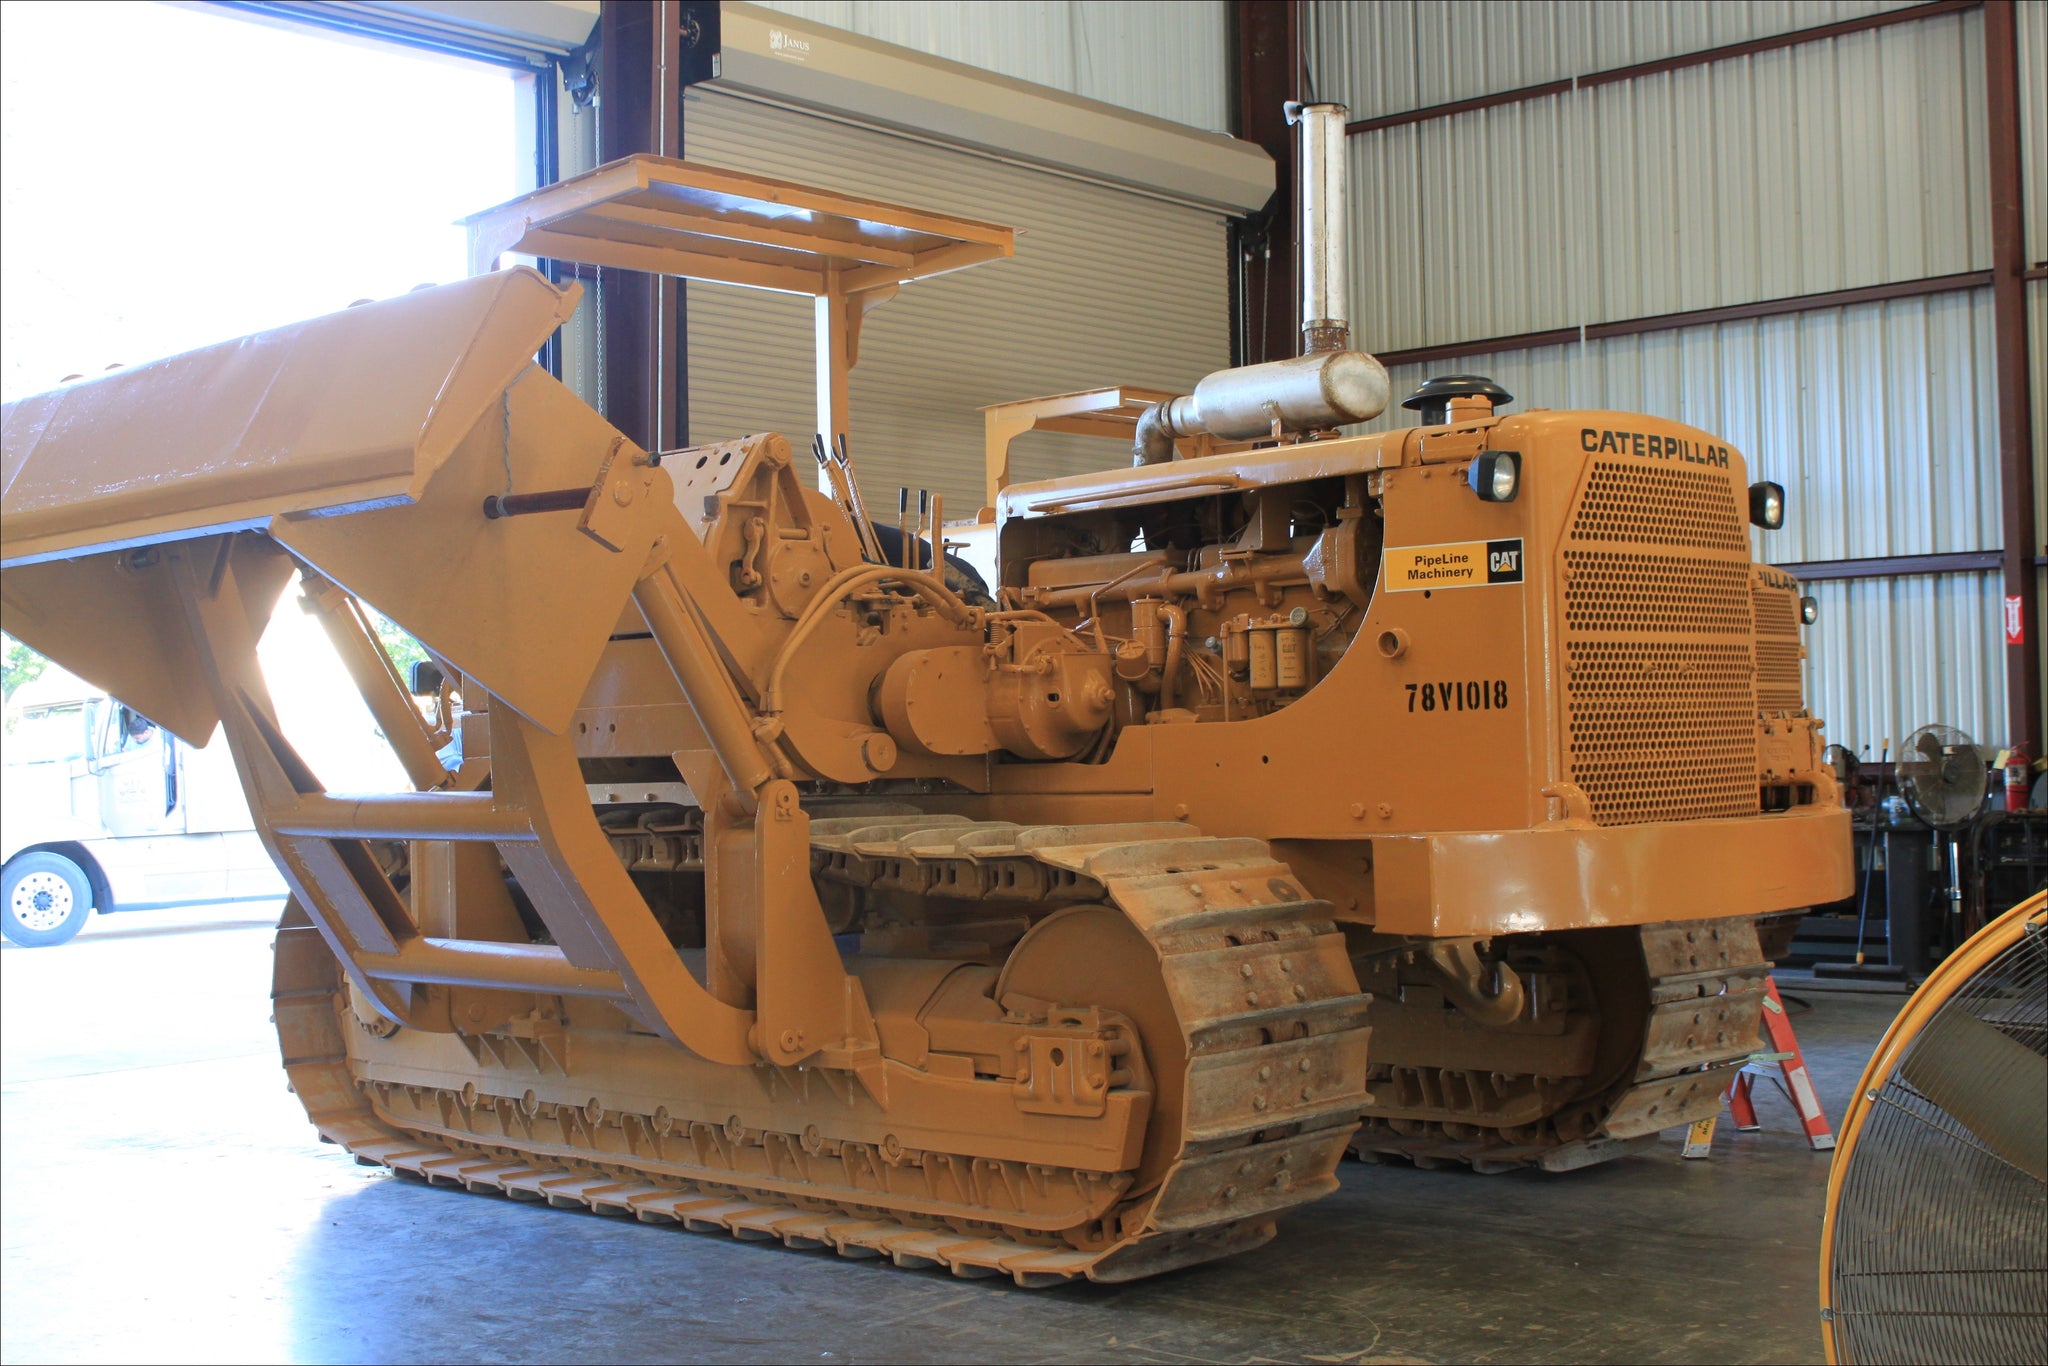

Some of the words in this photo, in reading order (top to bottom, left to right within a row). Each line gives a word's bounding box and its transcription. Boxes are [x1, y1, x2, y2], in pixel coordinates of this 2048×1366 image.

[782, 34, 810, 52] JANUS
[1580, 428, 1730, 470] CATERPILLAR
[1415, 553, 1470, 568] PipeLine
[1490, 551, 1520, 573] CAT
[1407, 567, 1474, 581] Machinery
[1404, 680, 1508, 713] 78V1018
